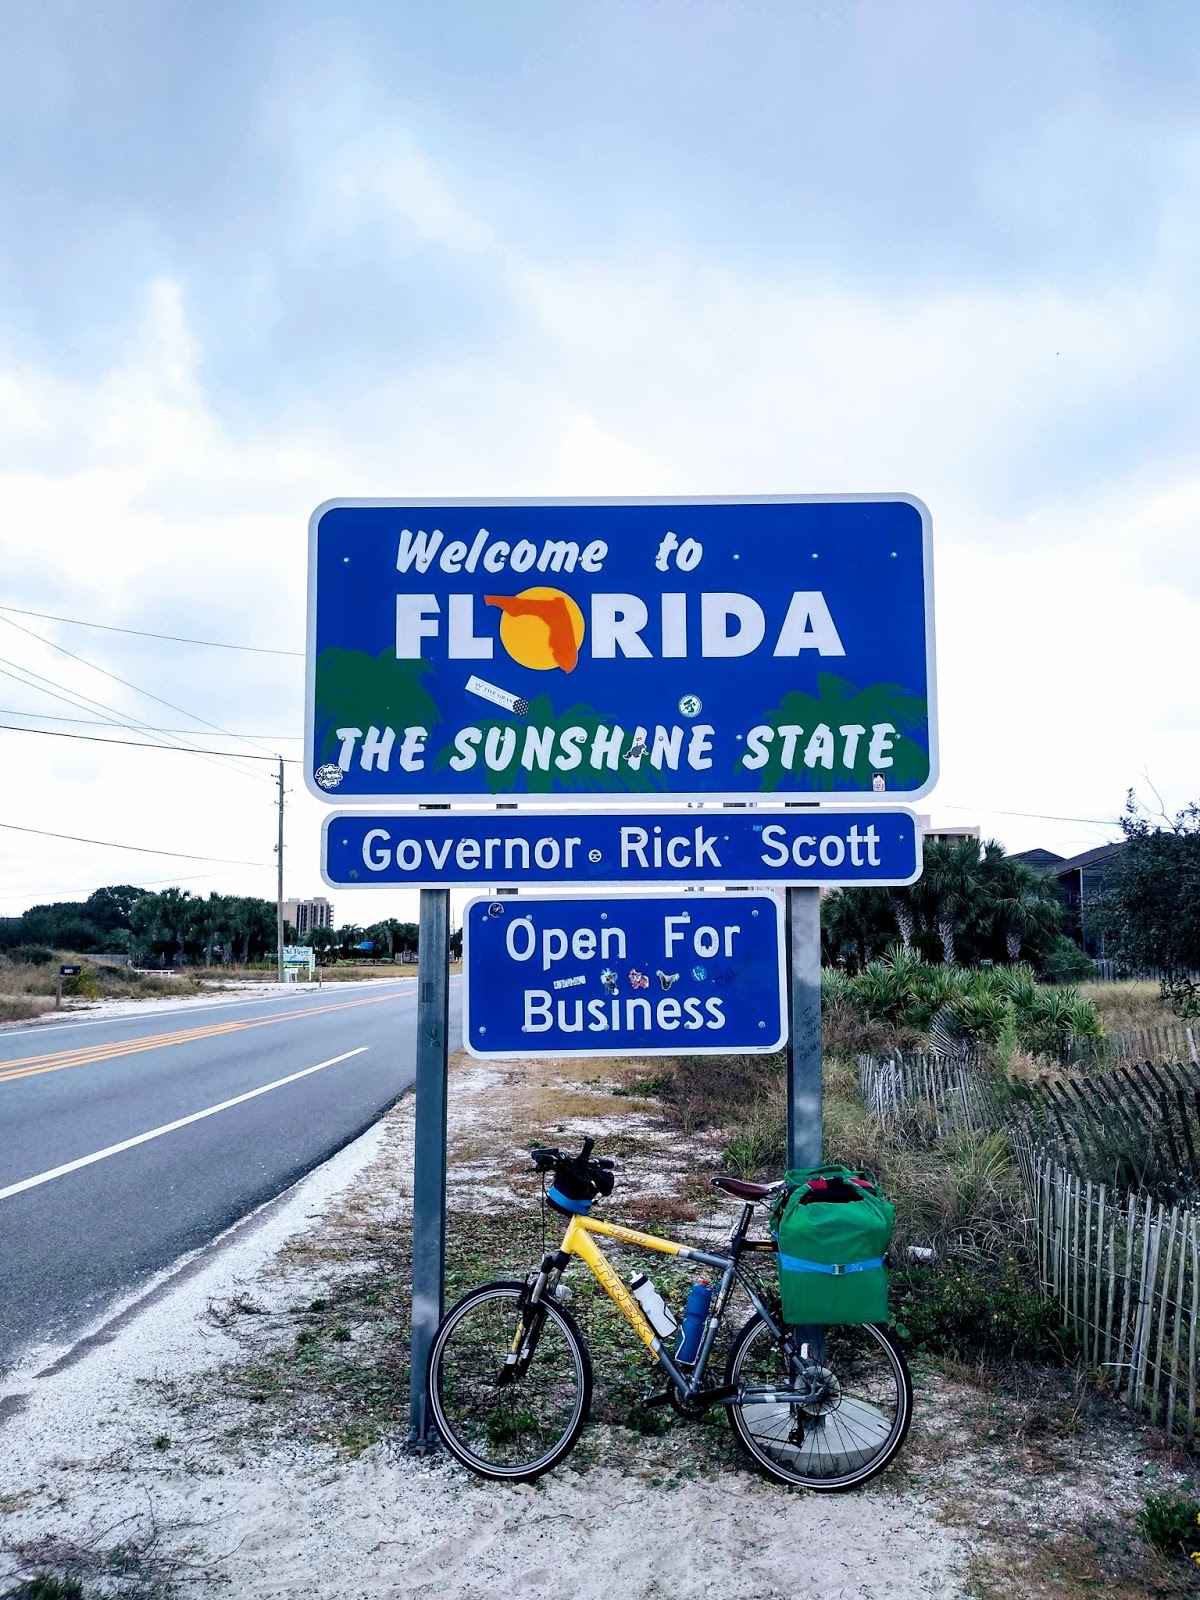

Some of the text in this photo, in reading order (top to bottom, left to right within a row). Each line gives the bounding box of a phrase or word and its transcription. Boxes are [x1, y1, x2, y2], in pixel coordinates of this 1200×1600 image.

[397, 528, 703, 574] Welcome to
[336, 722, 896, 772] THE SUNSHINE STATE
[362, 824, 881, 872] Governor Rick Scott
[506, 915, 741, 971] Open For
[522, 989, 726, 1033] Business
[593, 1257, 653, 1338] TREK
